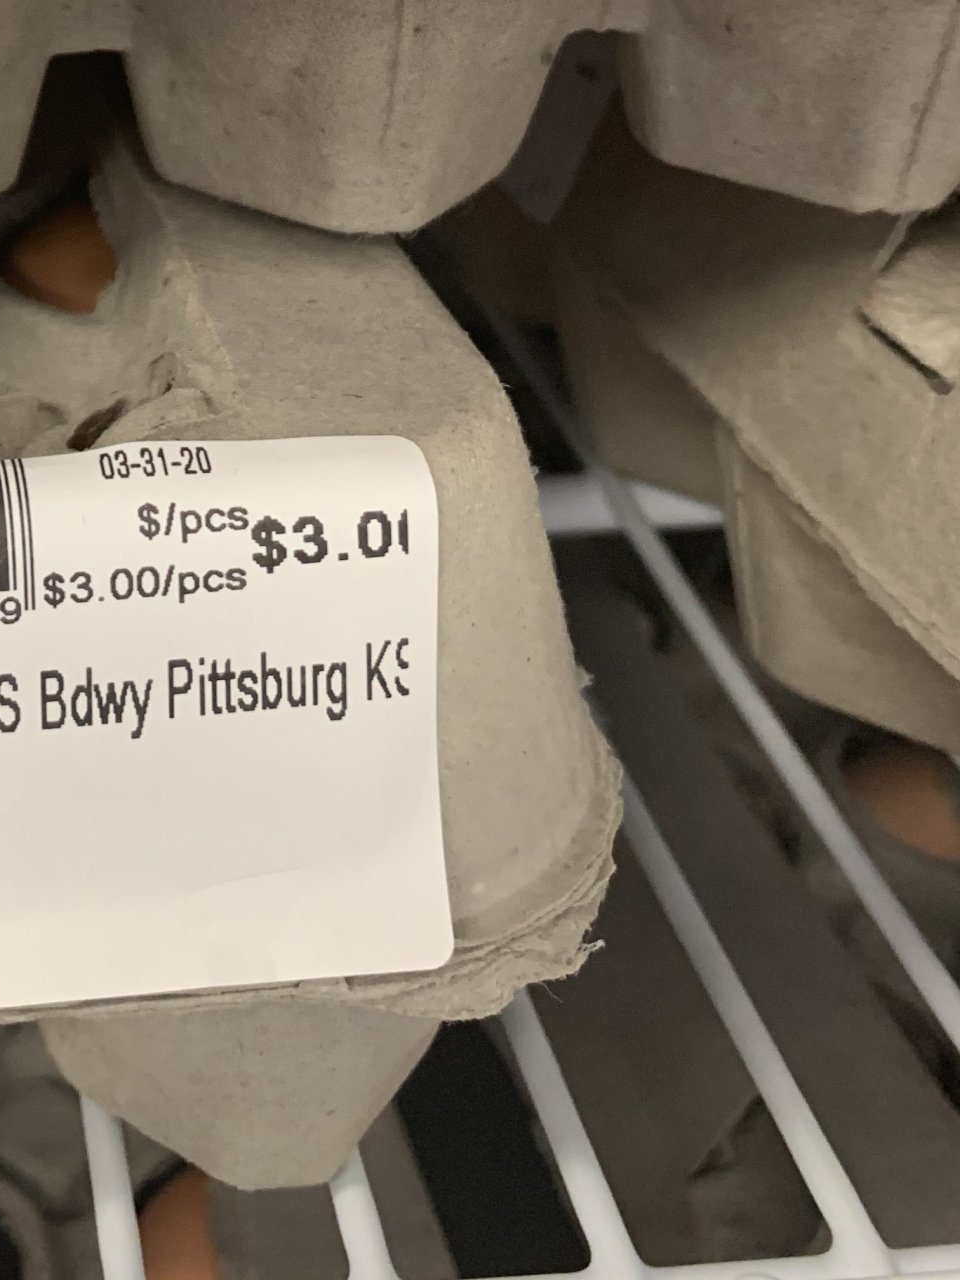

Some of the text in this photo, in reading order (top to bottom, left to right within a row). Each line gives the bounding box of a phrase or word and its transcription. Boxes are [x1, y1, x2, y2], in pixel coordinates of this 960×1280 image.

[99, 446, 212, 480] 03-31-20
[137, 502, 250, 543] $/pcs
[42, 564, 248, 608] $3.00/pcs
[40, 666, 153, 739] Bdwy
[167, 651, 348, 721] Pittsburg
